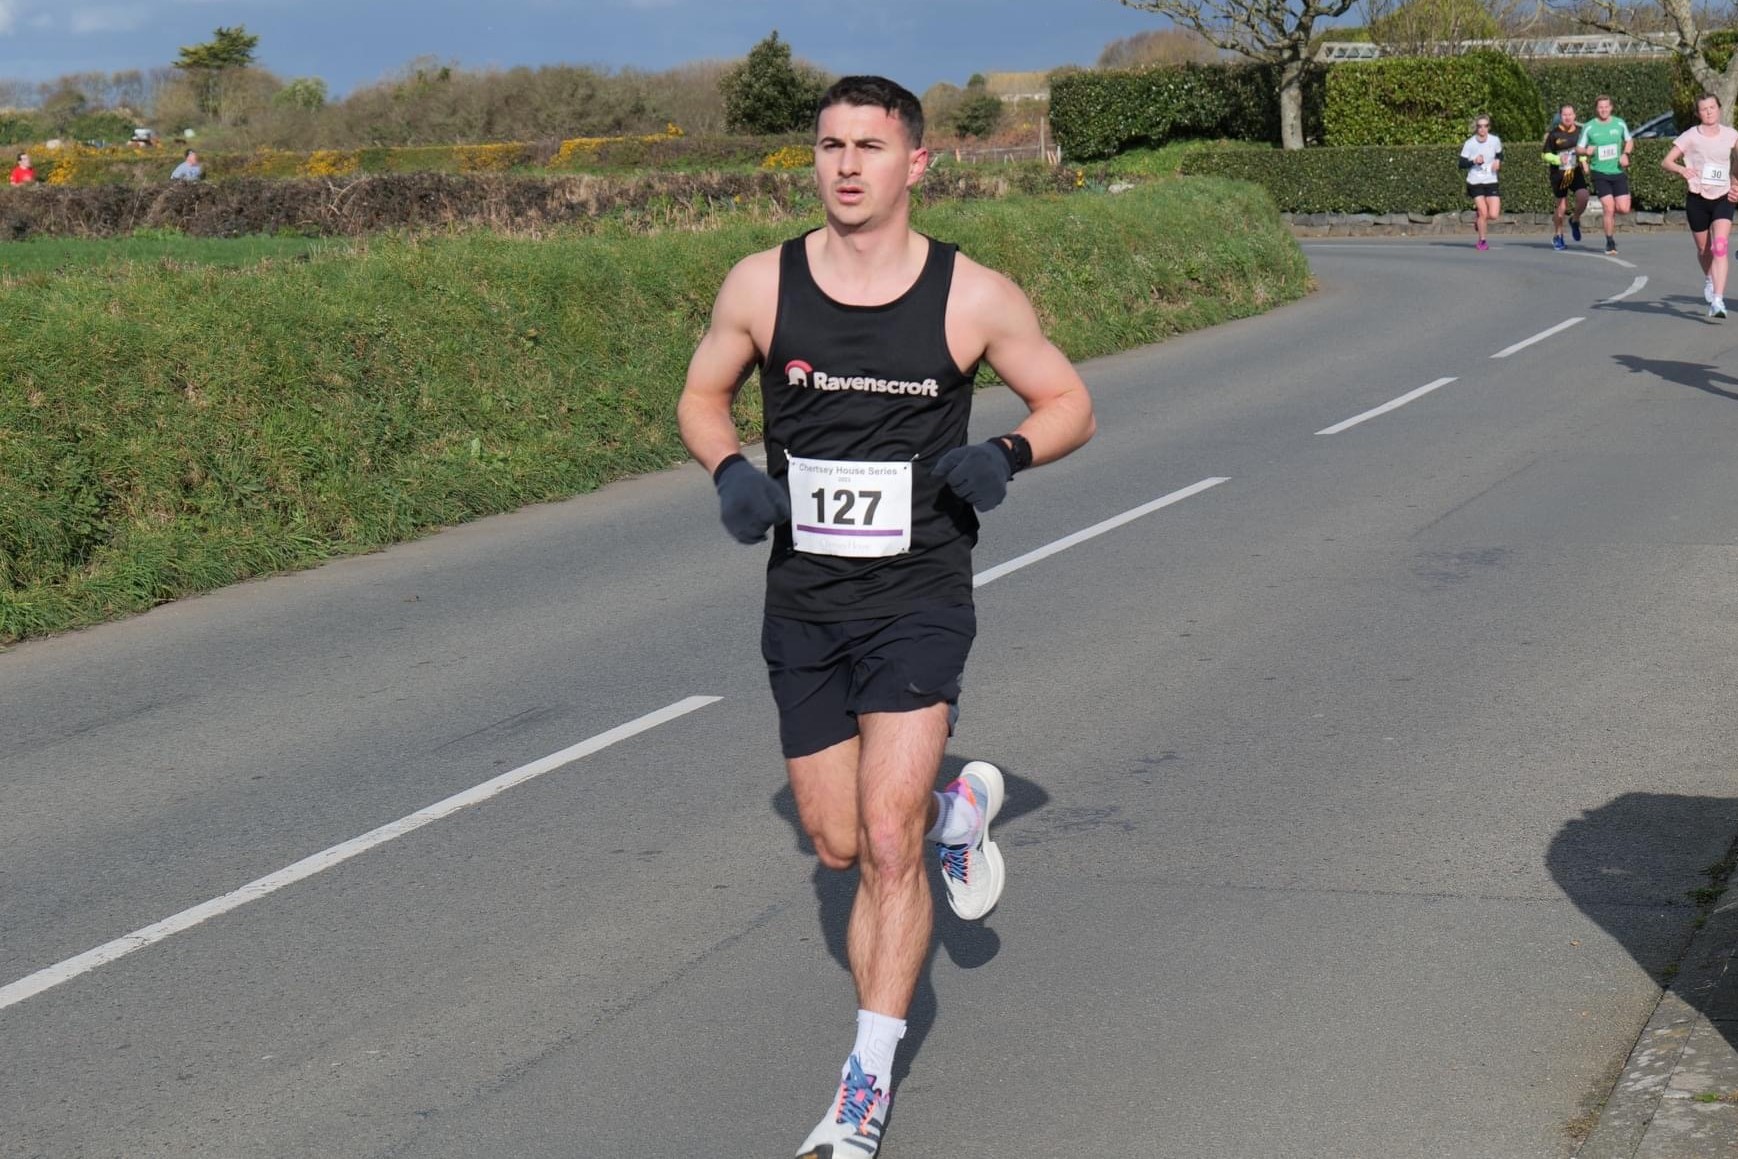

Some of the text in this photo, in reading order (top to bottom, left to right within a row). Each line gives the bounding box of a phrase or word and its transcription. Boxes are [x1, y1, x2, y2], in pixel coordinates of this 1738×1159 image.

[1711, 169, 1722, 179] 30
[813, 371, 939, 397] Ravenscroft
[799, 463, 898, 476] Chertsey House Series
[811, 487, 882, 526] 127
